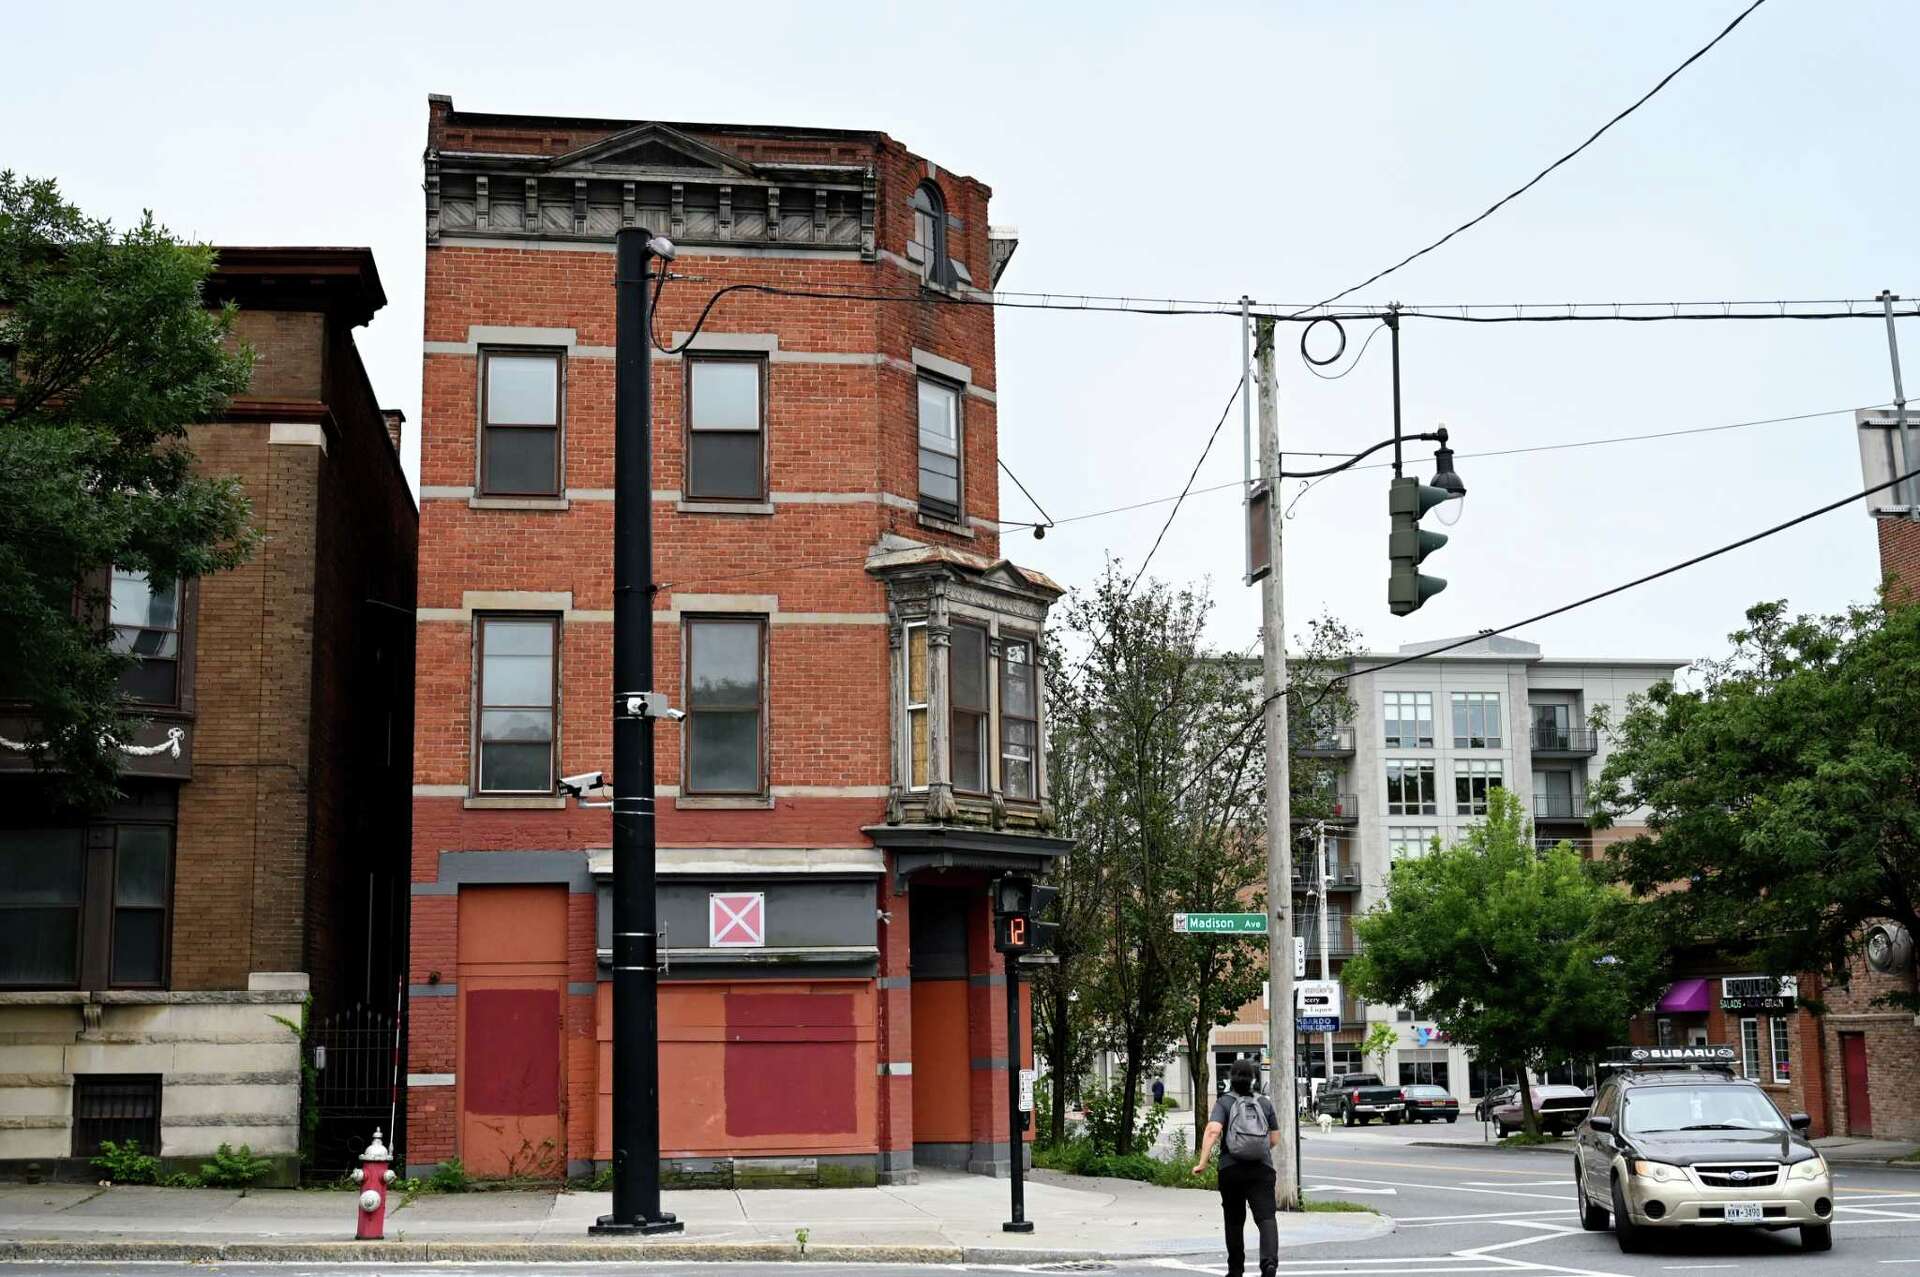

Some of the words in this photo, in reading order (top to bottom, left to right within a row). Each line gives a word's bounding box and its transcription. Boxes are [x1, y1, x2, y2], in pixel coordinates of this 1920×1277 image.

[1190, 918, 1234, 928] Madison
[1245, 920, 1261, 928] Ave
[1010, 919, 1024, 945] 12
[1720, 1000, 1742, 1009] SALADS
[1650, 1049, 1715, 1058] SUBARU
